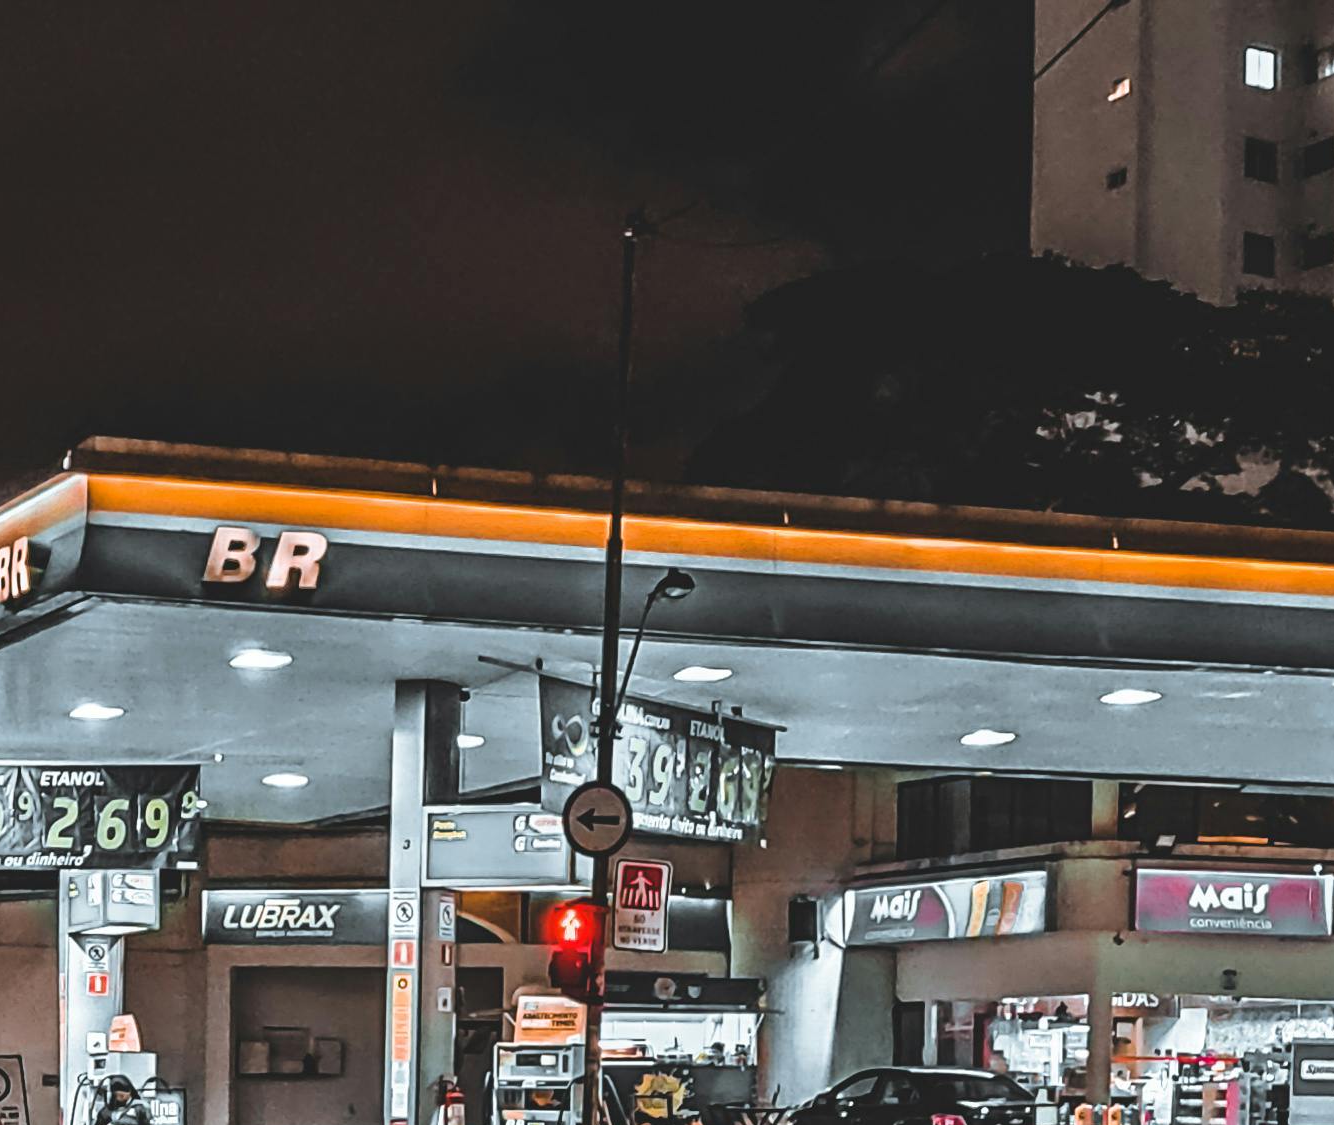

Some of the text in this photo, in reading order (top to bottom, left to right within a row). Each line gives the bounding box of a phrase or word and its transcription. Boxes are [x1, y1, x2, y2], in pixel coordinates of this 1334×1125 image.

[203, 526, 328, 590] BR
[40, 771, 104, 786] ETANOL
[403, 839, 411, 850] 3
[4, 856, 23, 867] ou
[26, 852, 85, 867] dinheiro
[870, 890, 921, 924] Mais
[1189, 882, 1270, 914] Mais
[223, 904, 341, 929] LUBRAX
[1189, 917, 1273, 929] conveniência
